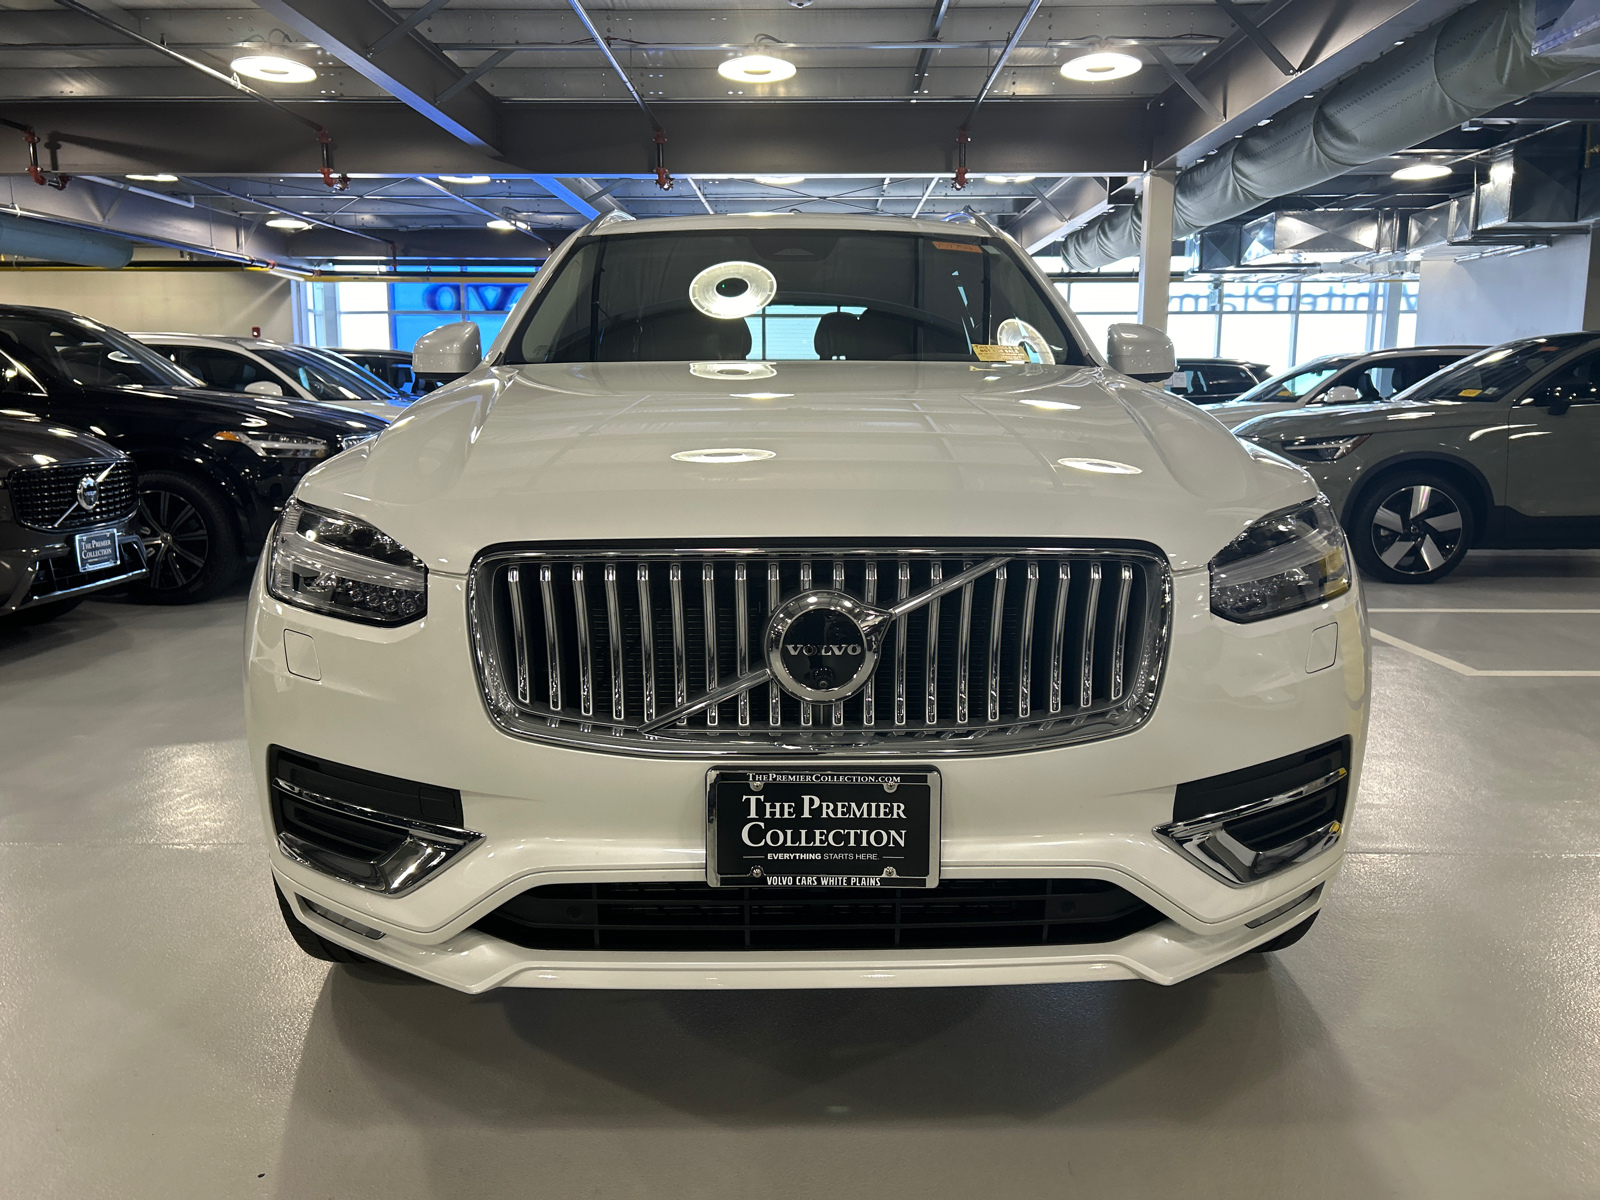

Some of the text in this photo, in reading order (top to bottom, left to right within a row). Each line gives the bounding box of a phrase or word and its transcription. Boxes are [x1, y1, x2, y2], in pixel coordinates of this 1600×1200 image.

[81, 547, 111, 559] COLLECTION
[786, 644, 862, 656] VOLVO
[742, 794, 907, 819] THE PREMIER
[741, 821, 907, 848] COLLECTION
[766, 876, 881, 886] VOLVO CARS WHITE PLAINS
